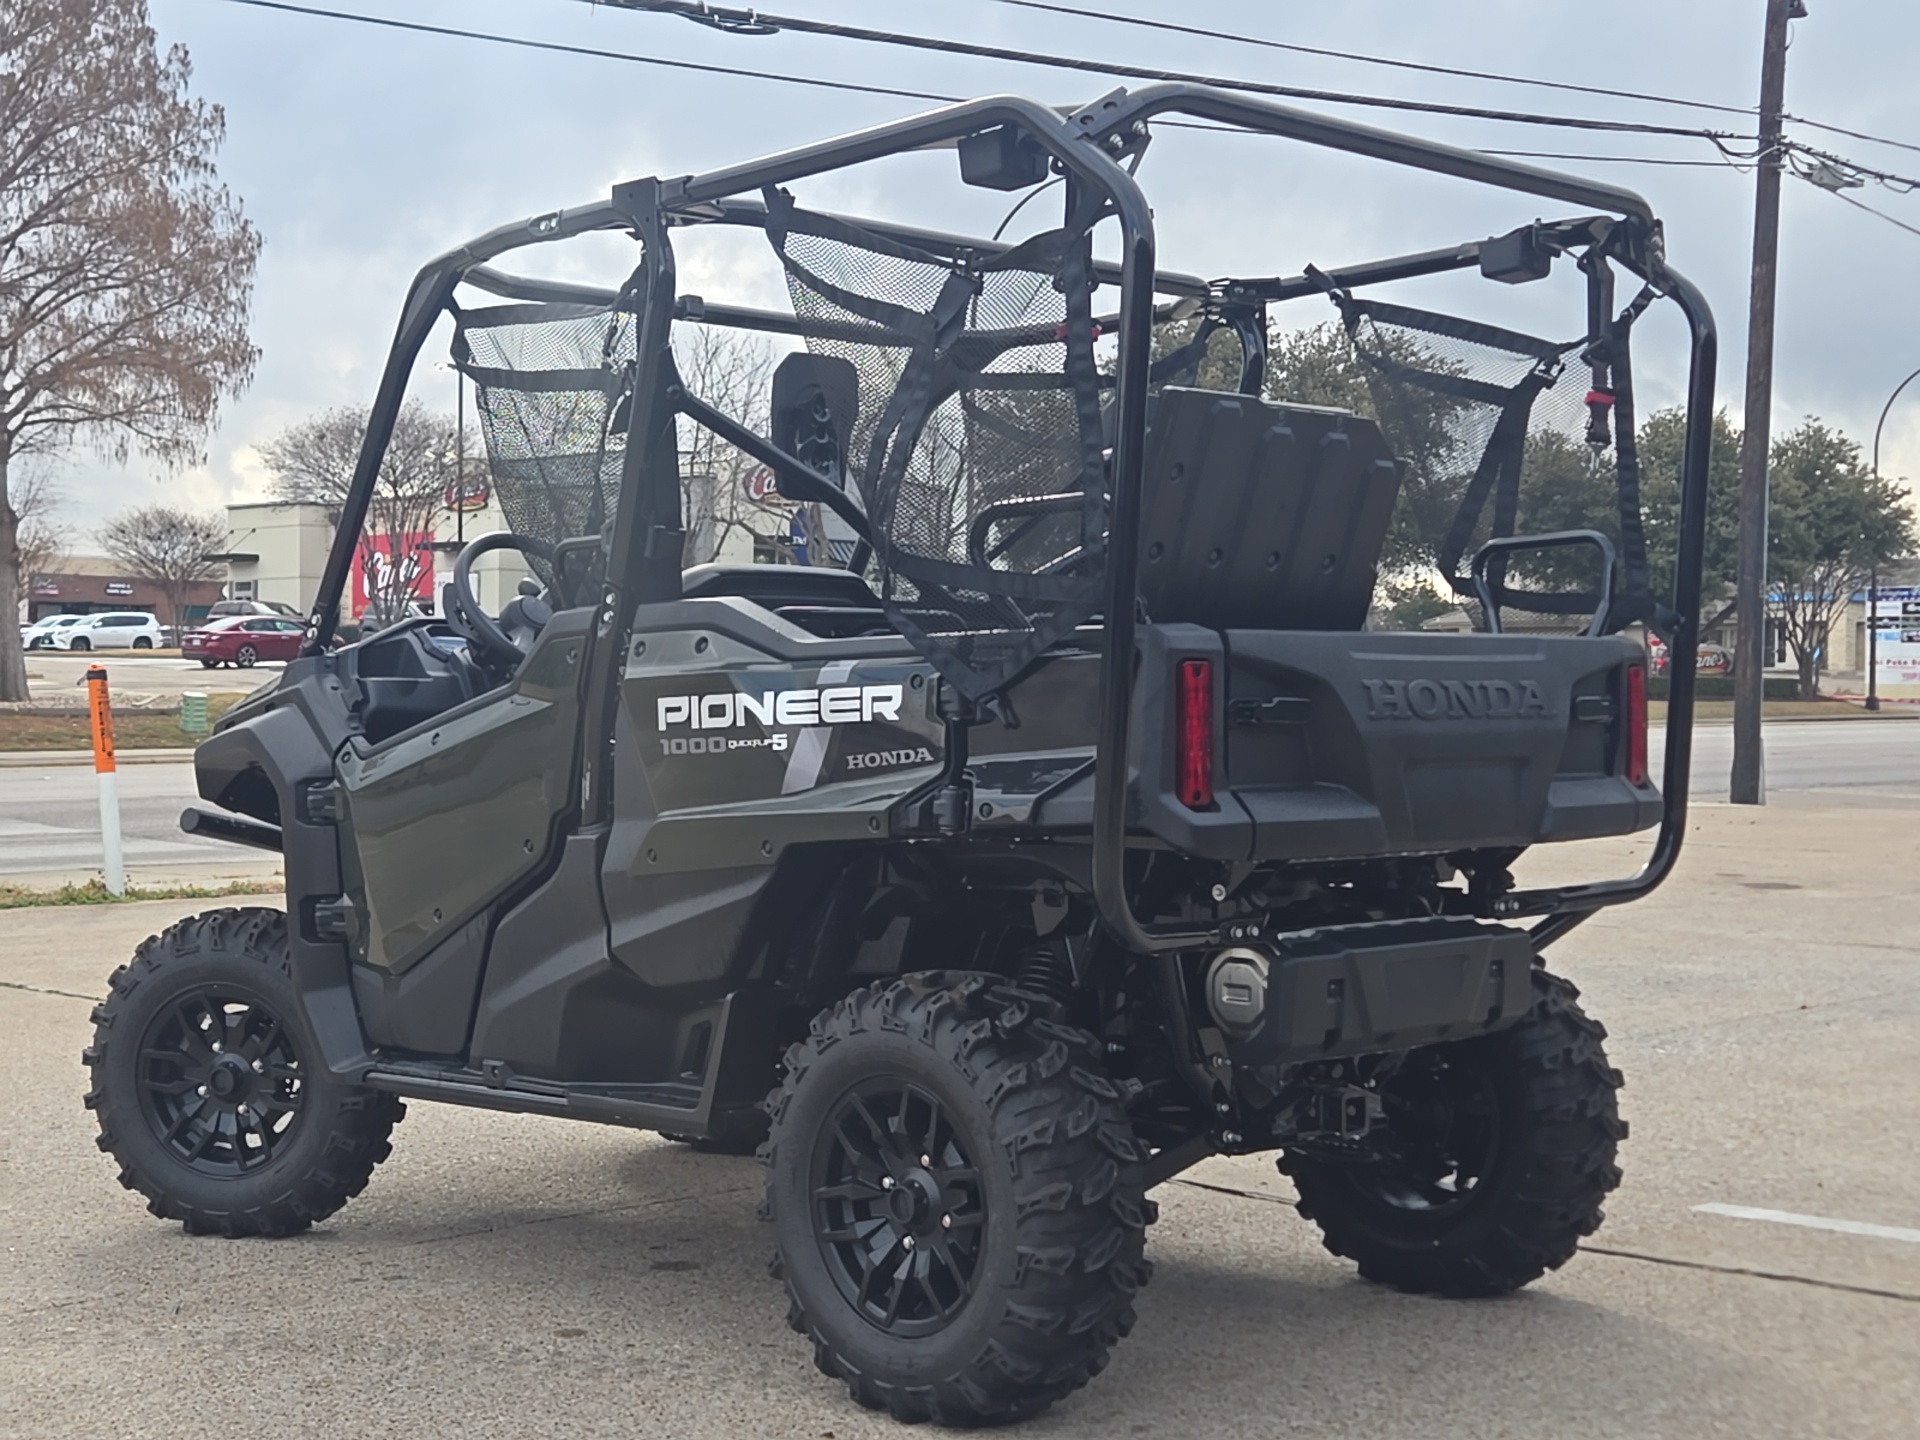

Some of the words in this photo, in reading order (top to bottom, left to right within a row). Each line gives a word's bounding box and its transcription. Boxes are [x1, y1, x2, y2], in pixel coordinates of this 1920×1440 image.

[657, 684, 903, 731] PIONEER
[1361, 678, 1557, 721] HONDA
[660, 736, 727, 755] 1000
[846, 747, 934, 770] HONDA
